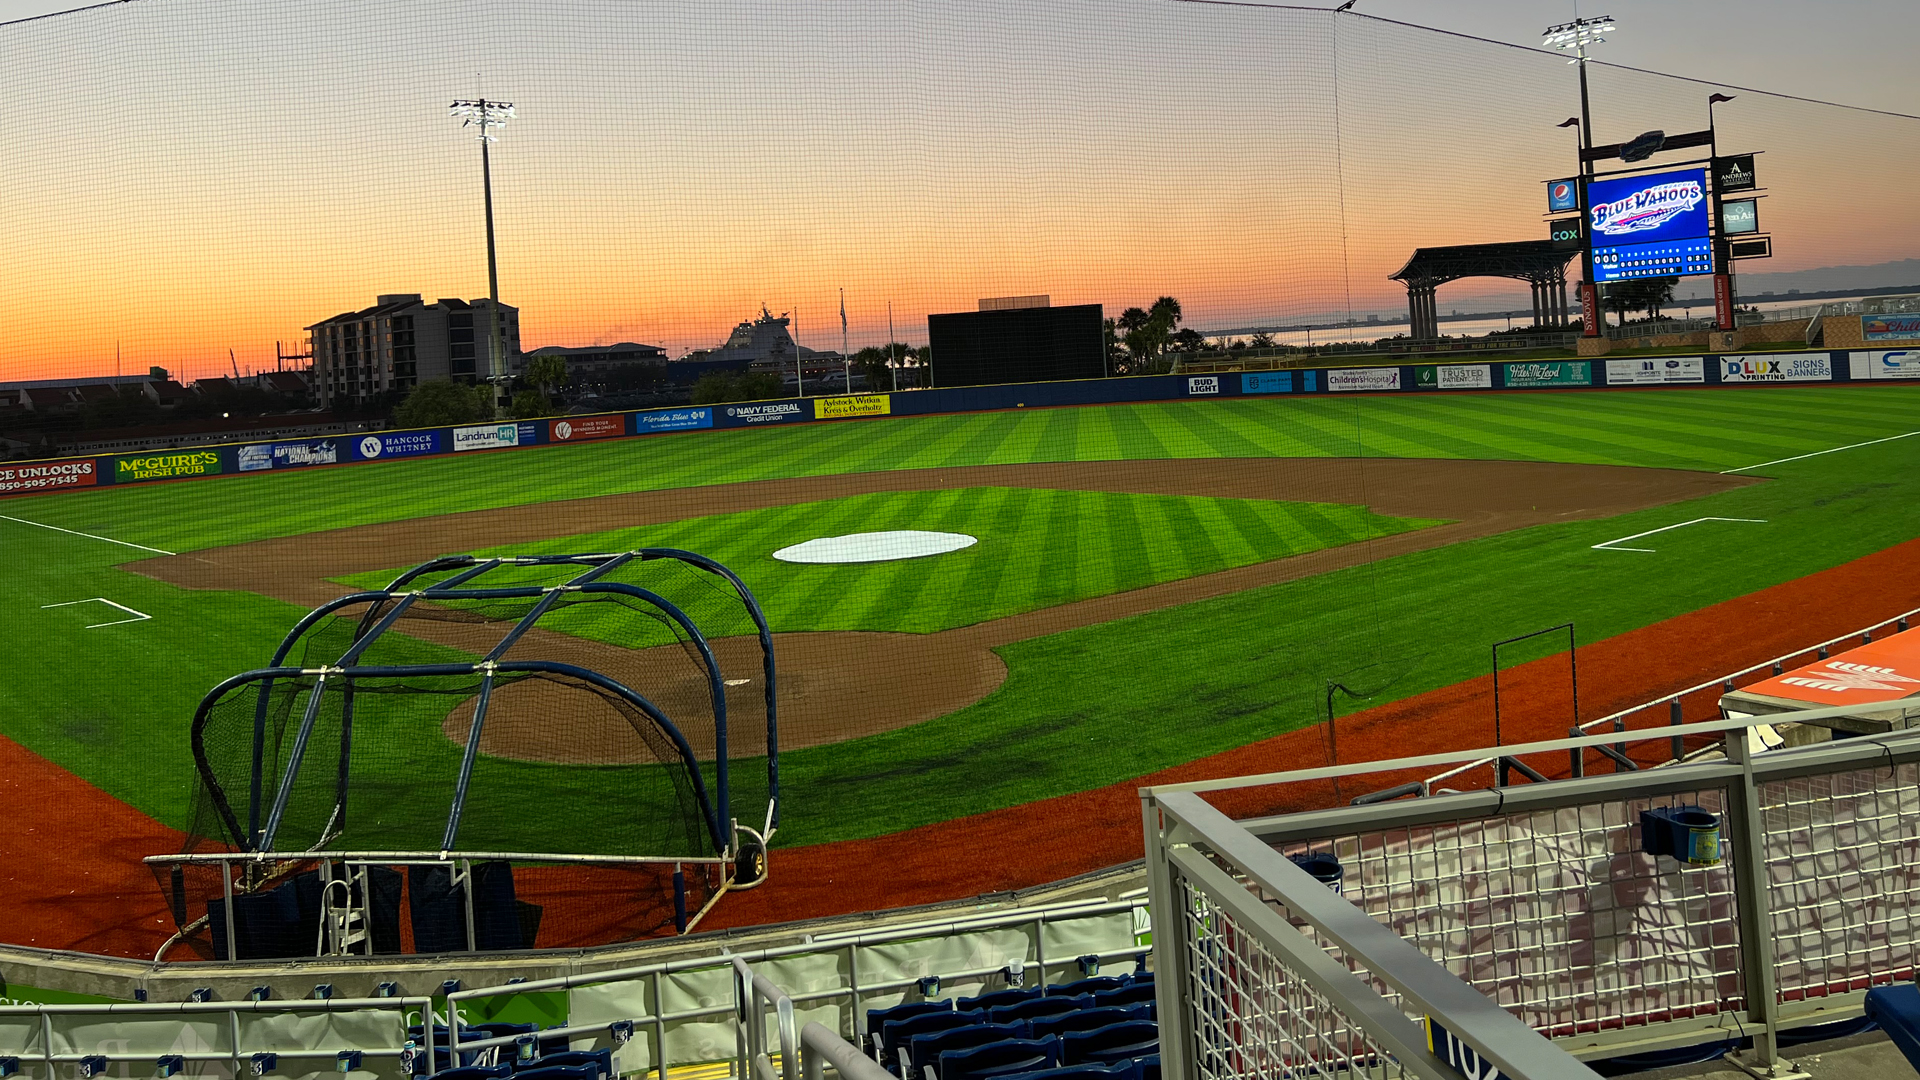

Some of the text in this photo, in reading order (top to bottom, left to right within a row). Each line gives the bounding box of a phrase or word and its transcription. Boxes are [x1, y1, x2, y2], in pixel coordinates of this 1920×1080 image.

[1721, 171, 1752, 180] ANDREWS
[1653, 182, 1696, 191] PENSACOLA
[1741, 211, 1755, 220] Air
[1584, 291, 1592, 330] SYNOVUS
[1728, 361, 1781, 374] DLUX
[1793, 360, 1824, 369] SIGNS
[1787, 368, 1830, 377] BANNERS
[1190, 385, 1217, 393] LIGHT
[737, 403, 800, 415] NAVY FEDERAL
[643, 414, 670, 423] Florida
[386, 435, 431, 445] HANCOCK
[275, 446, 310, 457] NATIONAL
[386, 443, 432, 453] WHITNEY
[289, 452, 333, 464] CHAMPIONS
[19, 463, 92, 478] UNLOCKS
[134, 465, 204, 479] IRISH PUB
[0, 475, 78, 490] 850-505-7545
